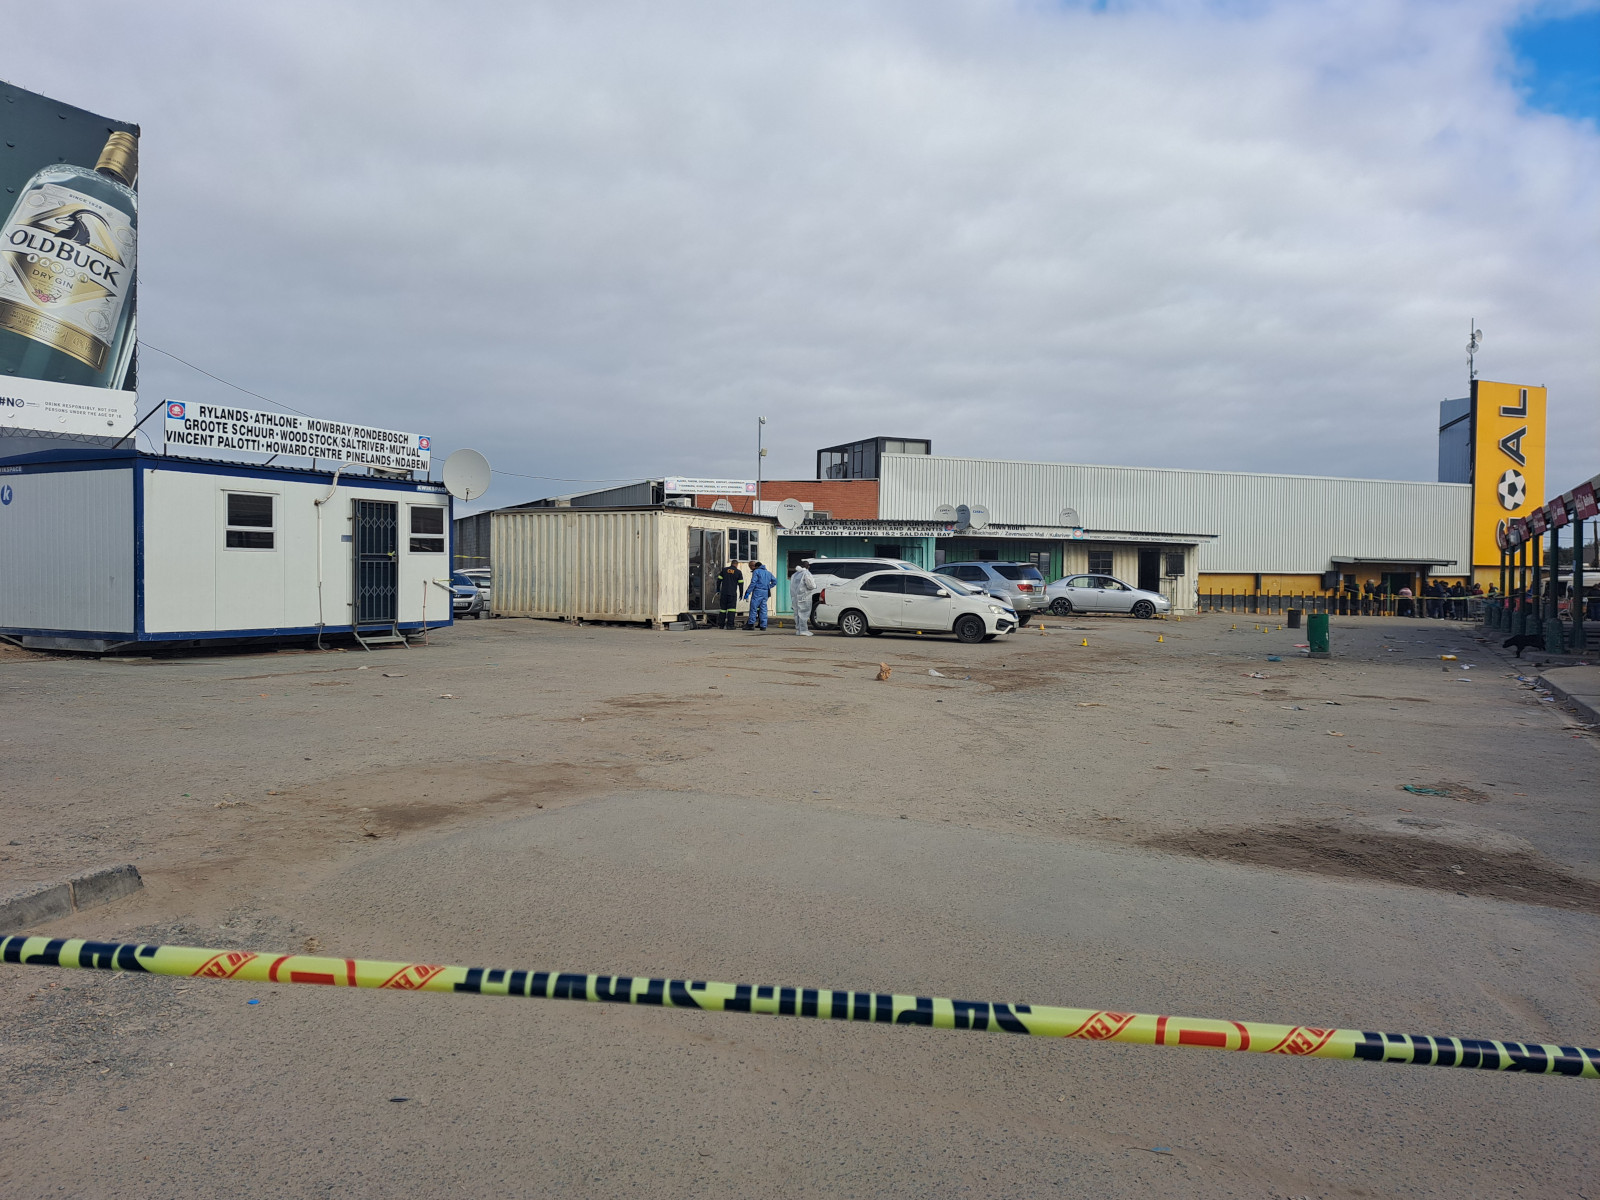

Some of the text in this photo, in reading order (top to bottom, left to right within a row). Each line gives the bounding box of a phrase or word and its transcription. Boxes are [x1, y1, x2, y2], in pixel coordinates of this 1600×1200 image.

[32, 269, 54, 280] DRY
[55, 278, 74, 289] GIN
[184, 419, 228, 434] GROOTE
[166, 430, 214, 446] VINCENT
